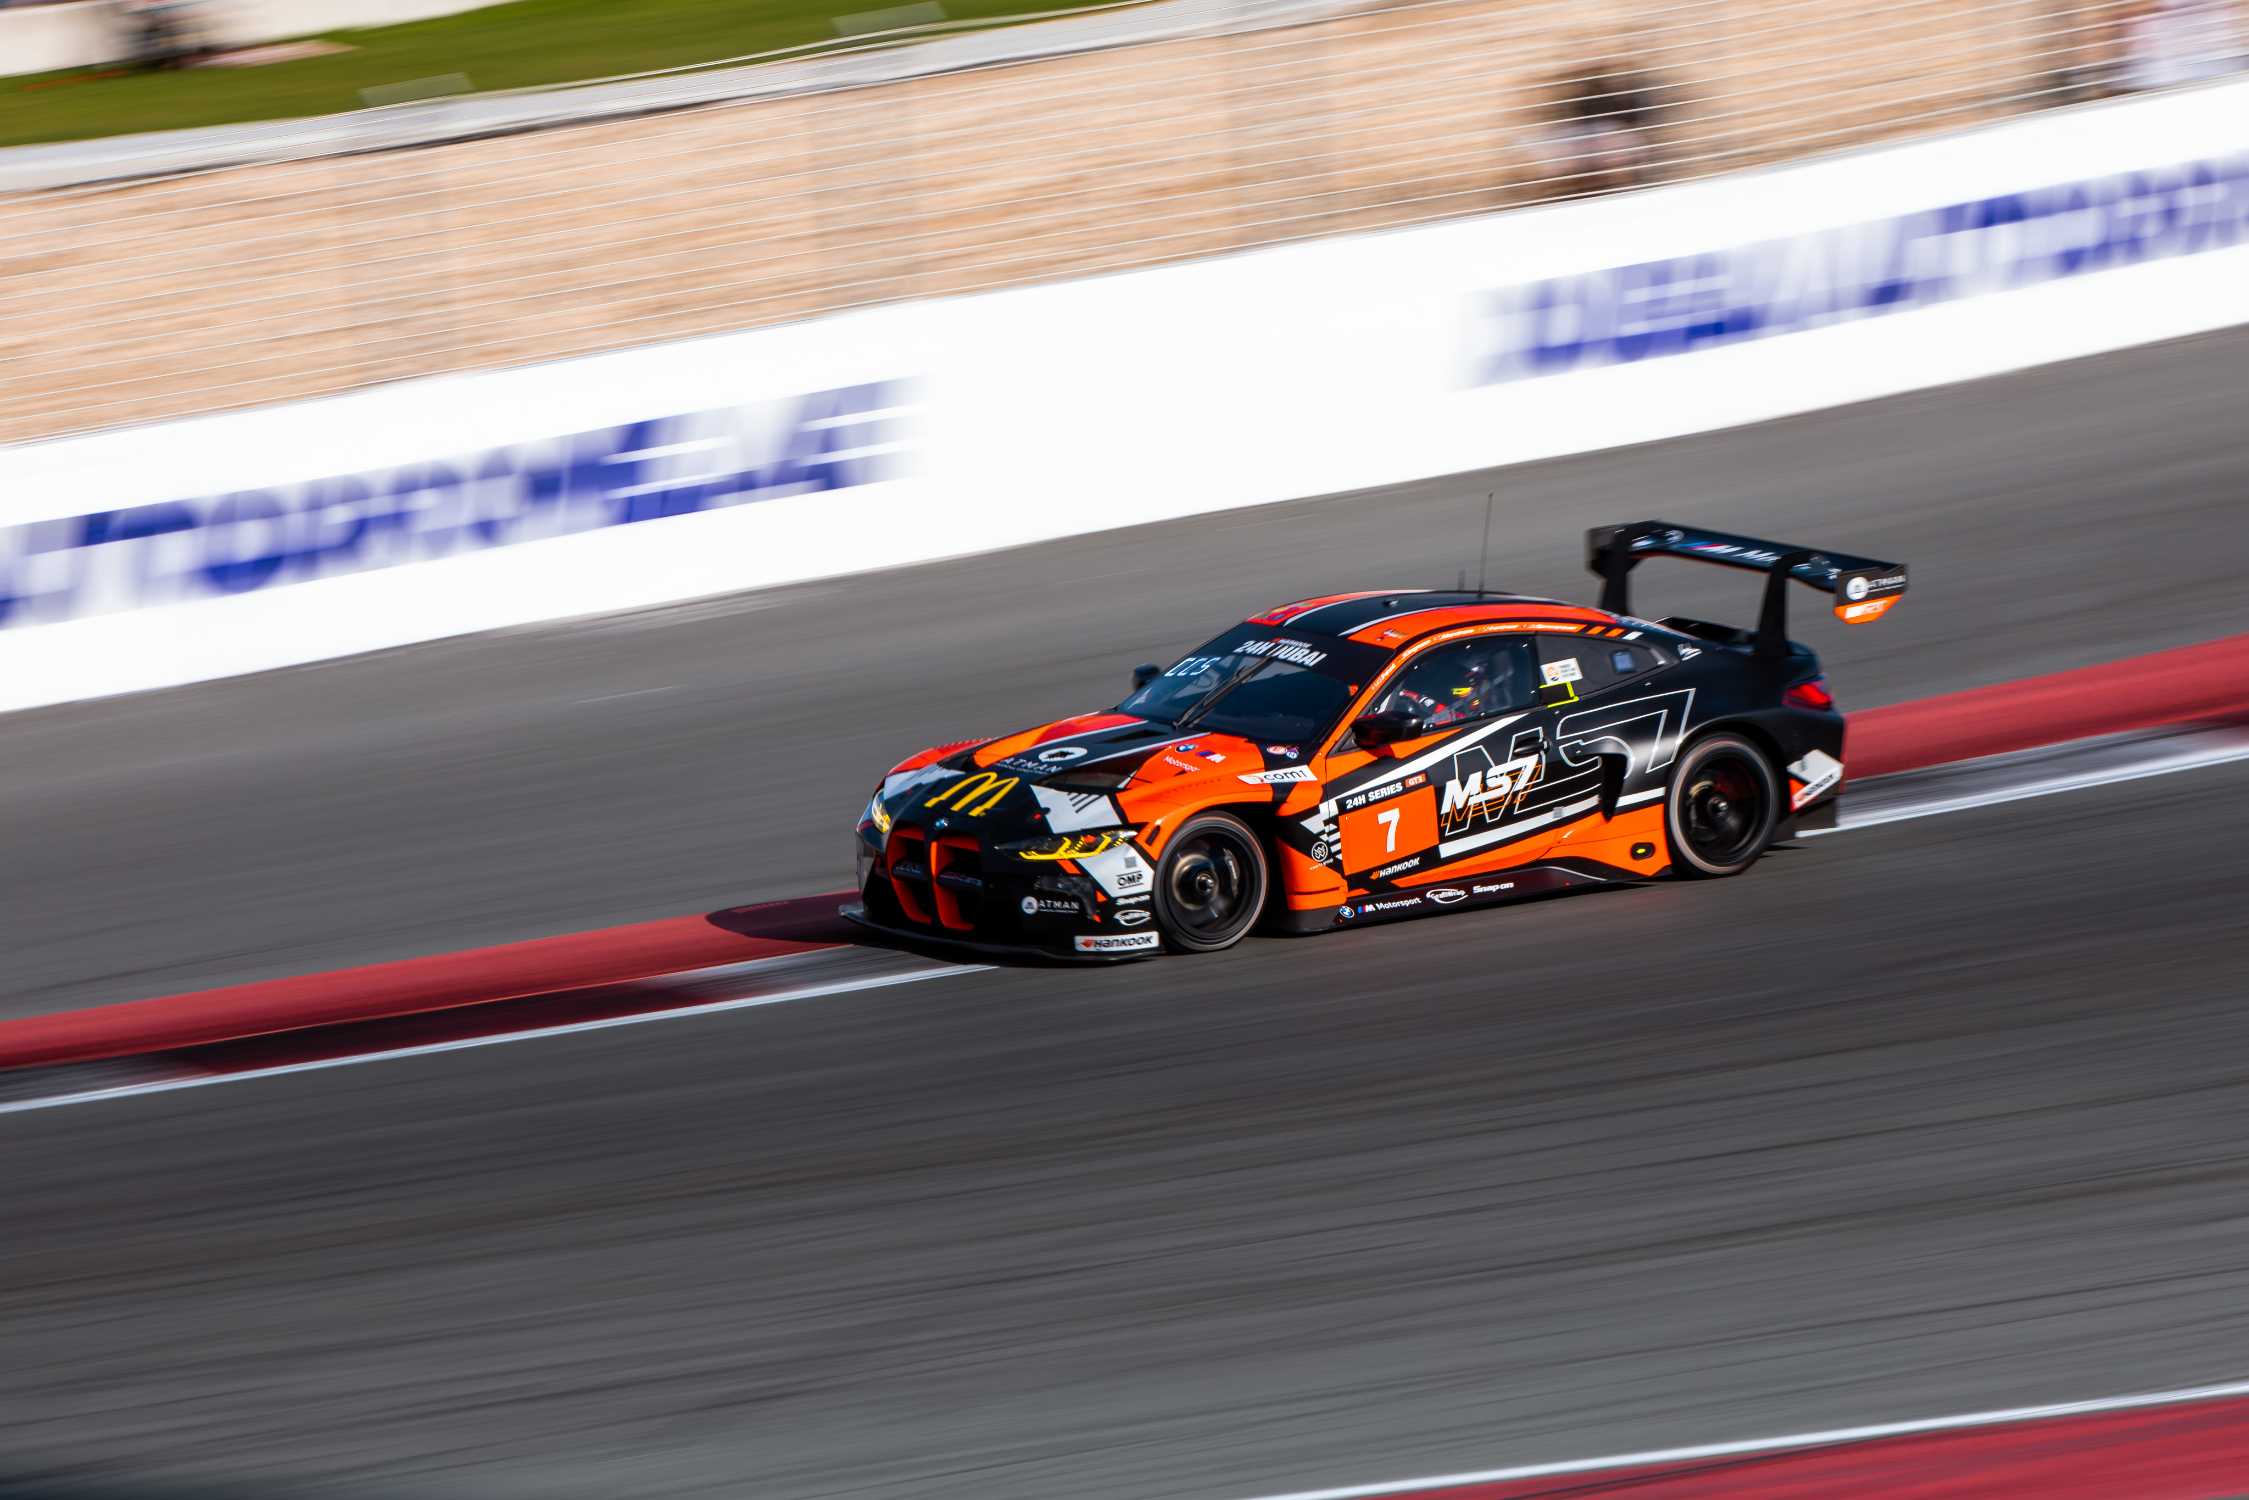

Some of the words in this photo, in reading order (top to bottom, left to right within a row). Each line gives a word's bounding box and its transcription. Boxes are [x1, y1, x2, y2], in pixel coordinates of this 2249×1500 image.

[1231, 640, 1276, 656] 24H
[1345, 795, 1367, 809] 24H
[1368, 782, 1404, 802] SERIES
[1408, 774, 1425, 786] GT3
[1440, 754, 1540, 815] MS7
[1376, 807, 1401, 854] 7
[1117, 874, 1144, 887] OMP
[1038, 899, 1080, 911] ATMAN
[1376, 897, 1422, 911] Motorsport
